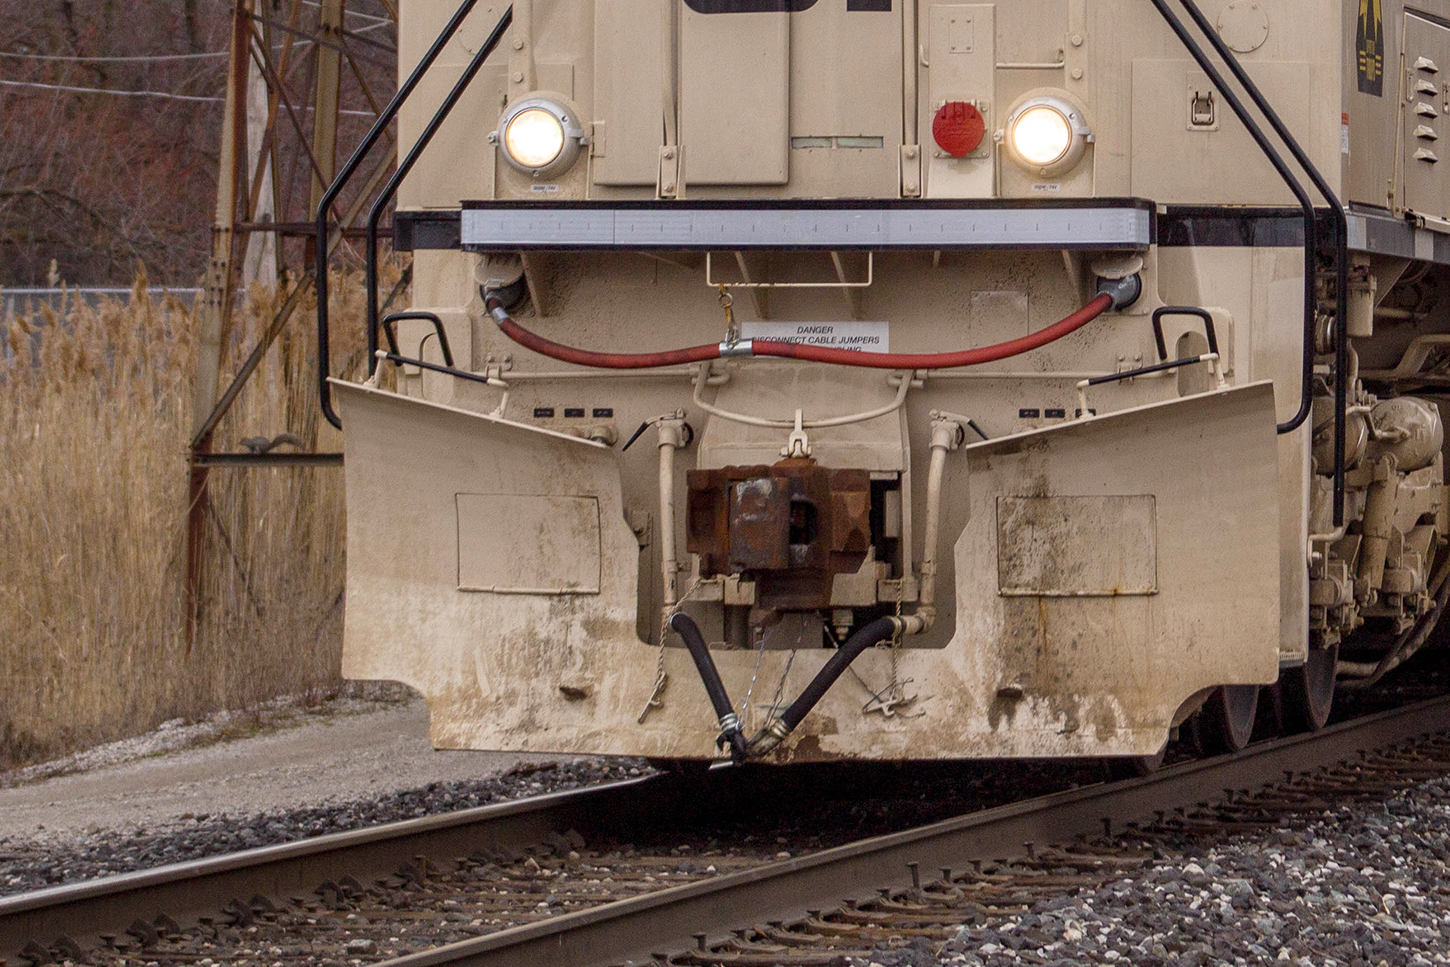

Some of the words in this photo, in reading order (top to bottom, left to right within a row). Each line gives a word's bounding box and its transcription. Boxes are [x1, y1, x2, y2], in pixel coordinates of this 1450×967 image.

[797, 326, 834, 334] DANGER
[808, 336, 836, 344] CABLE
[839, 336, 880, 344] JUMPERS
